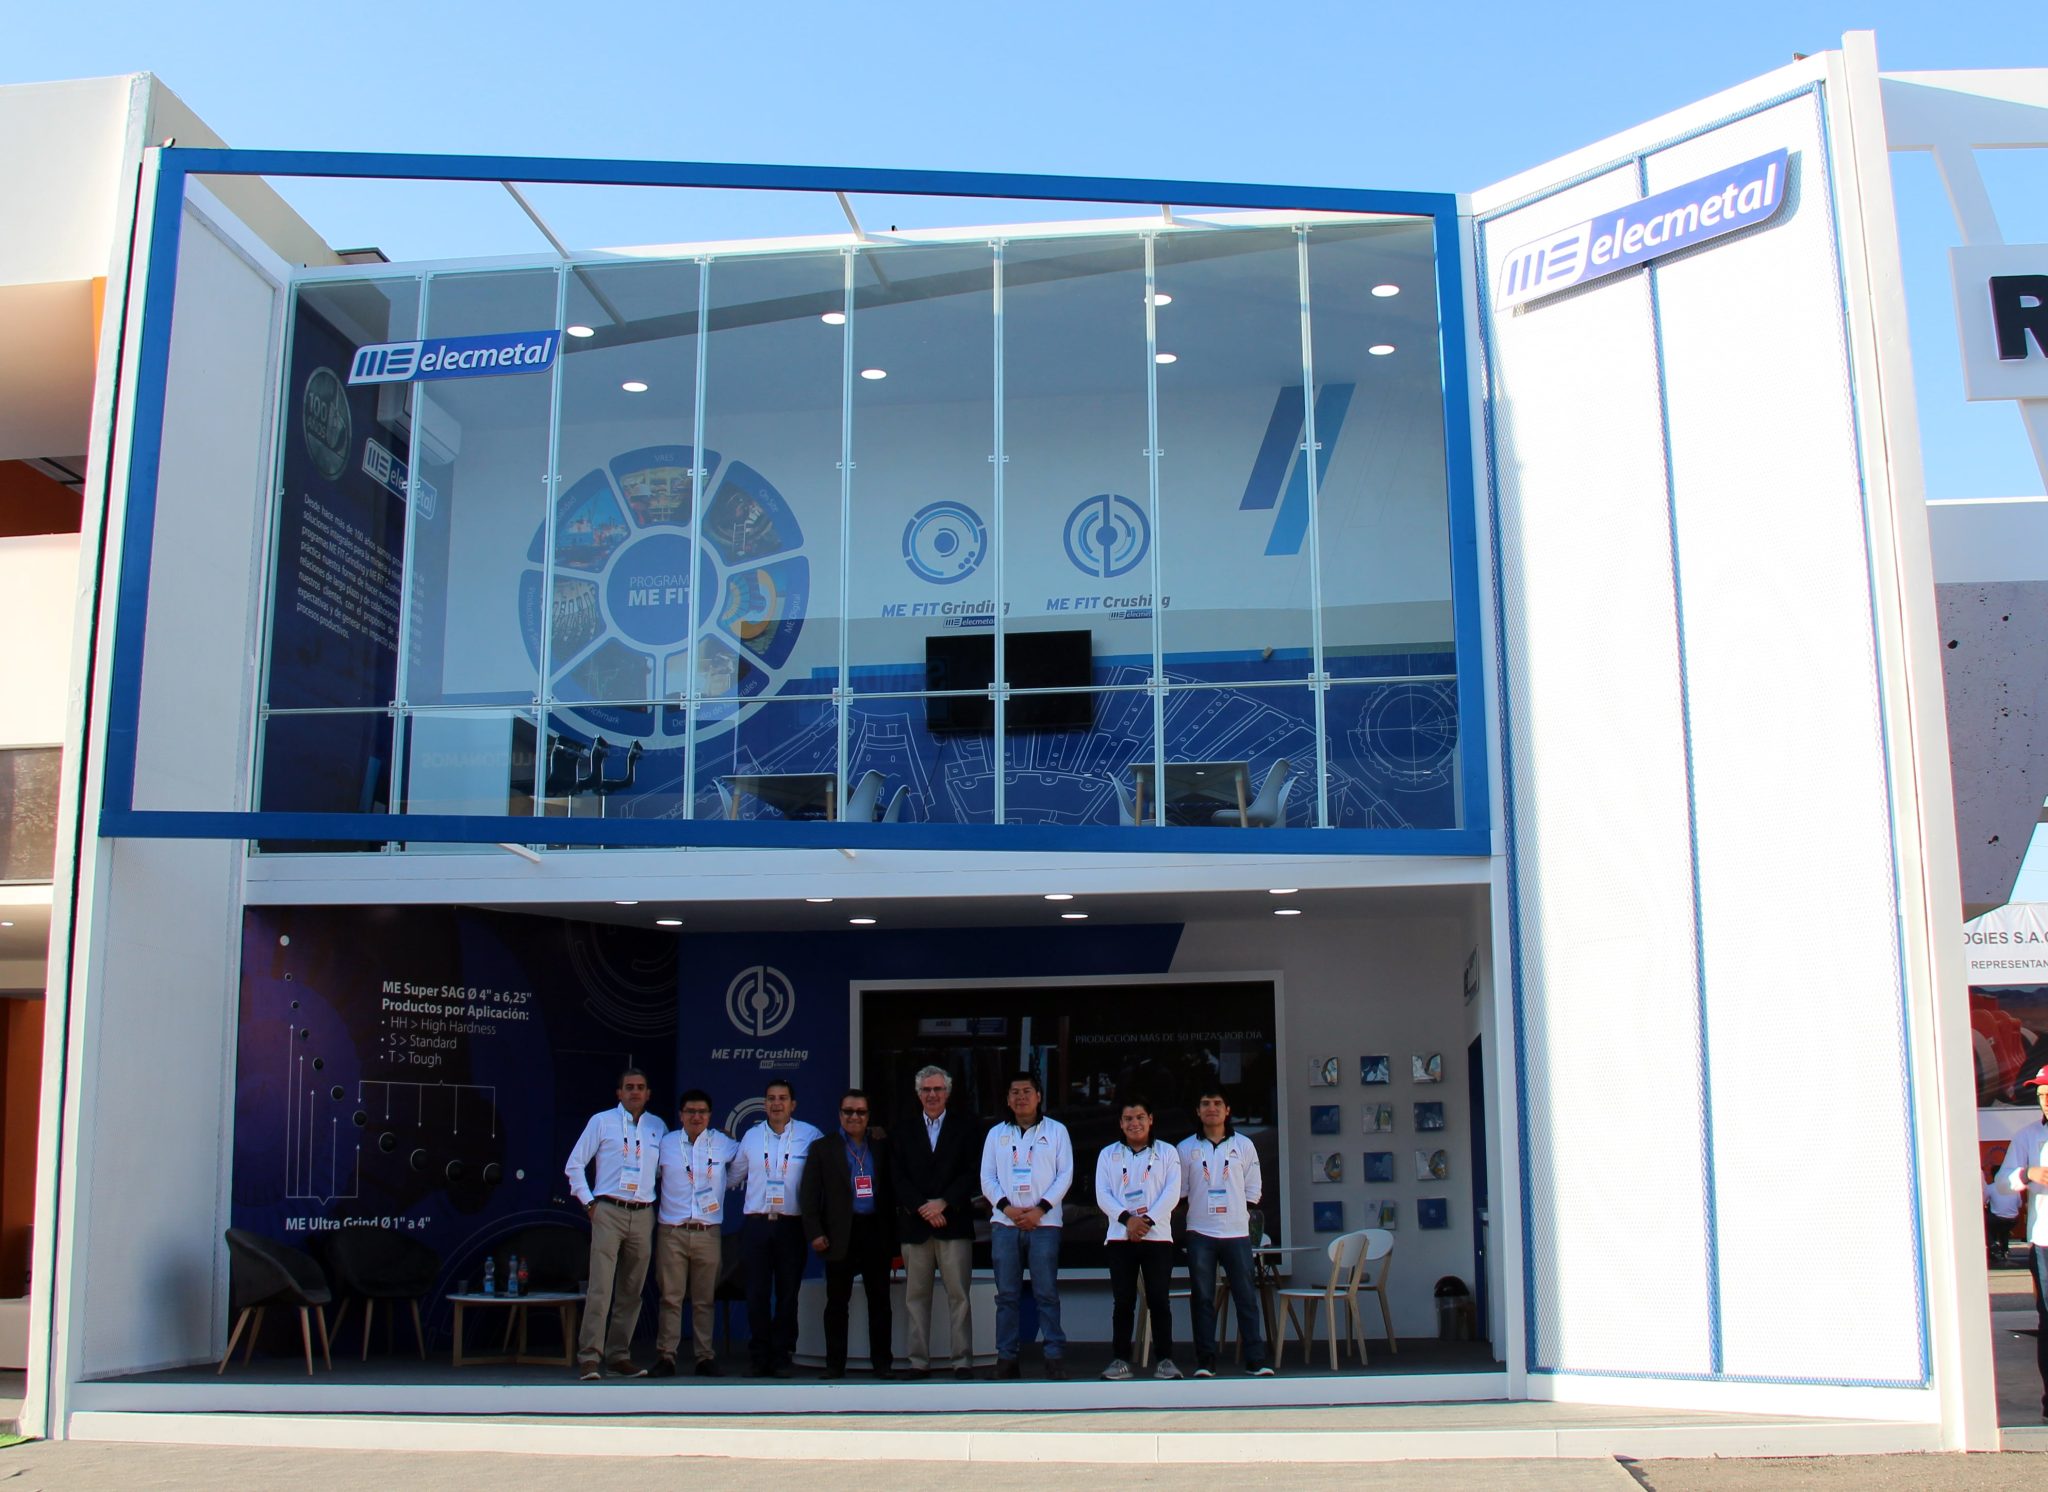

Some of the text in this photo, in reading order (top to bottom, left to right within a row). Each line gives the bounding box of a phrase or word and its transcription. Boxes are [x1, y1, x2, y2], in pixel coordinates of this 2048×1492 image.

[1591, 163, 1777, 266] elecmetal
[420, 337, 551, 372] elecmetal
[309, 392, 328, 422] 100
[303, 510, 328, 534] soluciones
[302, 526, 327, 550] programas
[345, 552, 365, 576] Grinding
[298, 572, 320, 591] nuestros
[322, 555, 340, 572] nuestra
[365, 580, 377, 596] hacer
[630, 574, 690, 587] PROGRAM
[628, 589, 660, 606] ME
[1046, 594, 1171, 611] ME FIT Crushig
[297, 604, 318, 622] procesos
[882, 599, 1010, 617] ME FIT Grindig
[383, 981, 532, 1004] ME Super SAG Ø 4" a 6,25"
[382, 998, 530, 1021] Productos por Aplicación:
[390, 1016, 408, 1030] HH
[421, 1018, 447, 1034] High
[449, 1020, 497, 1035] Hardness
[390, 1033, 397, 1046] S
[410, 1034, 457, 1049] Standard
[1162, 1032, 1175, 1042] DE
[388, 1050, 396, 1063] T
[408, 1051, 442, 1067] Tough
[712, 1047, 808, 1061] ME FIT Crushing
[285, 1218, 306, 1231] ME
[309, 1217, 341, 1230] Ultra
[381, 1217, 391, 1229] Ø
[393, 1216, 405, 1229] 1"
[407, 1220, 415, 1229] a
[417, 1216, 431, 1229] 4"
